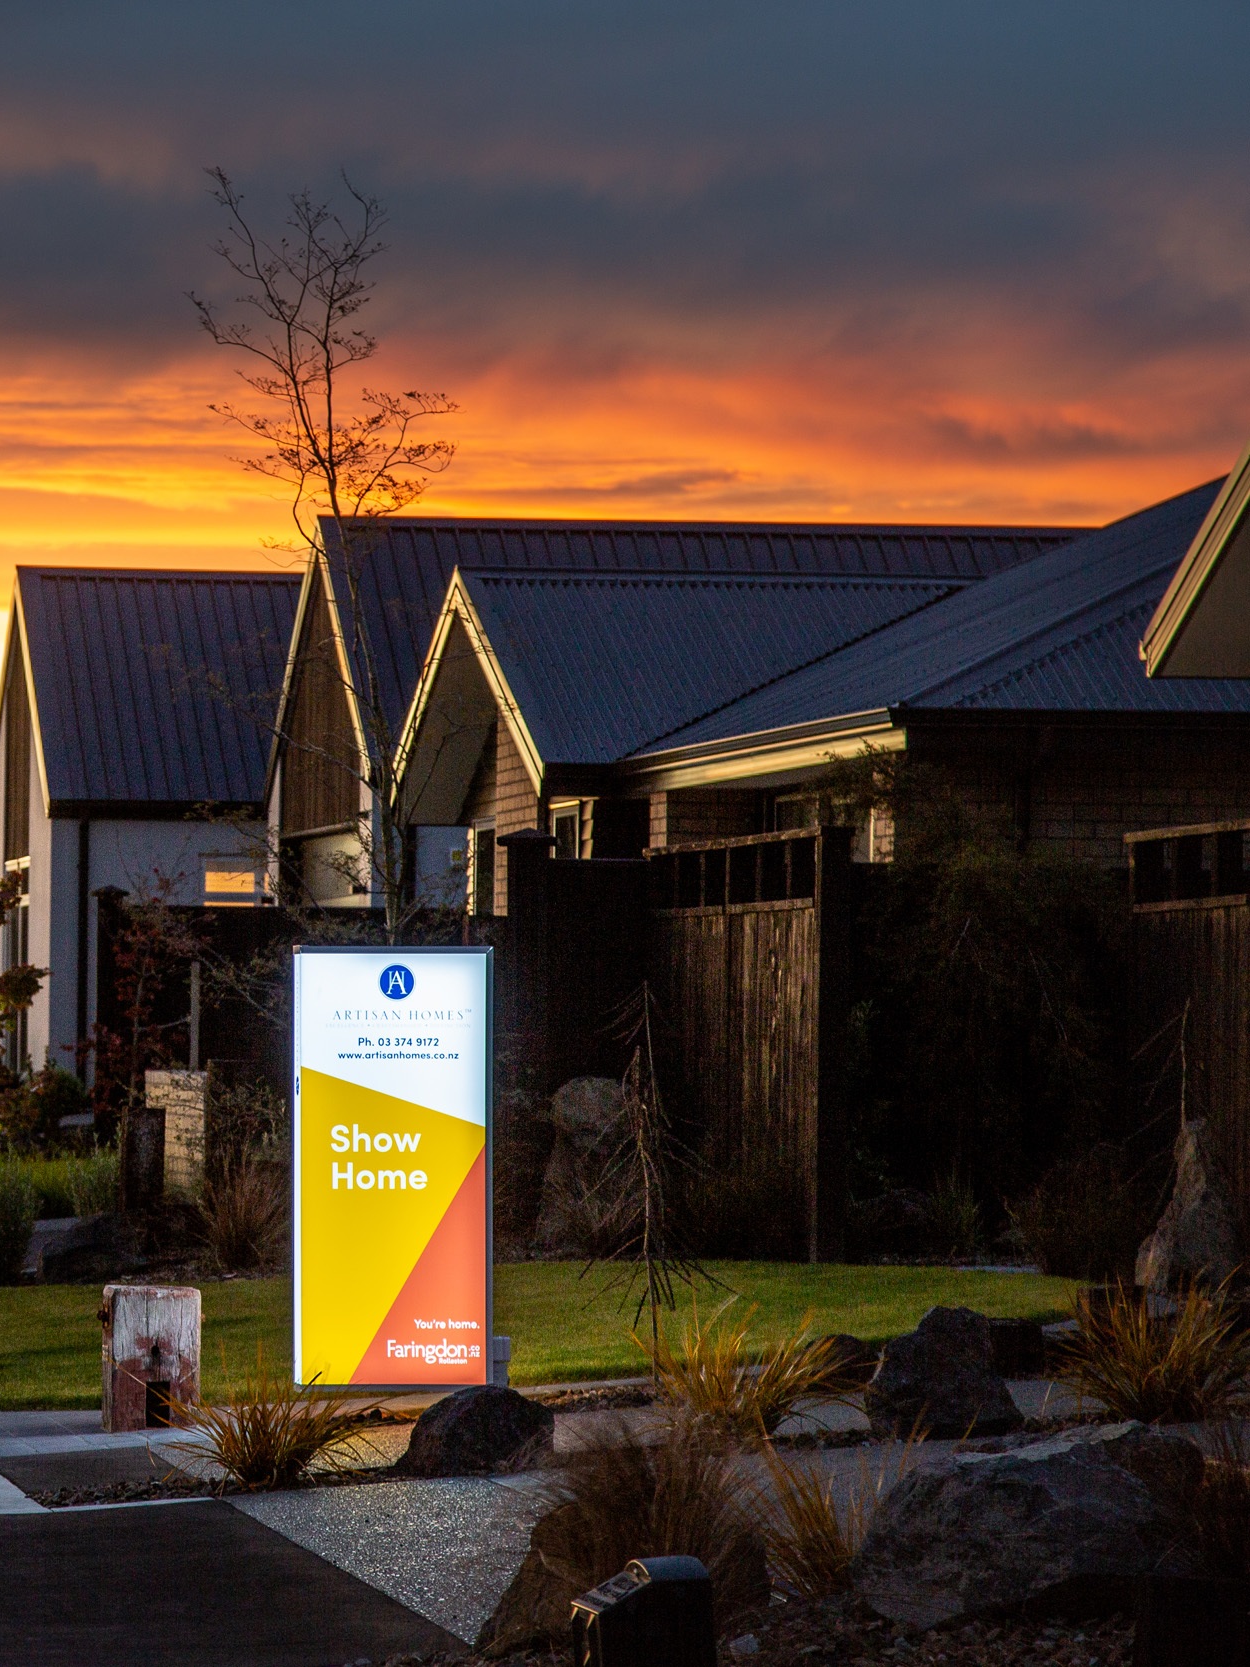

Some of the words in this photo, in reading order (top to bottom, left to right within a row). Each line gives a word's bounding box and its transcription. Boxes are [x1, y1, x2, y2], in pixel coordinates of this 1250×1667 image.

[332, 1010, 400, 1020] ARTISAN
[358, 1037, 375, 1047] Ph.
[378, 1037, 391, 1047] 03
[394, 1037, 413, 1047] 374
[416, 1037, 439, 1047] 9172
[337, 1051, 459, 1060] www.artisanhomes.co.nz
[330, 1124, 421, 1153] Show
[331, 1162, 428, 1190] Home
[414, 1319, 447, 1329] You're
[448, 1319, 480, 1329] home.
[387, 1338, 468, 1364] Faringdon
